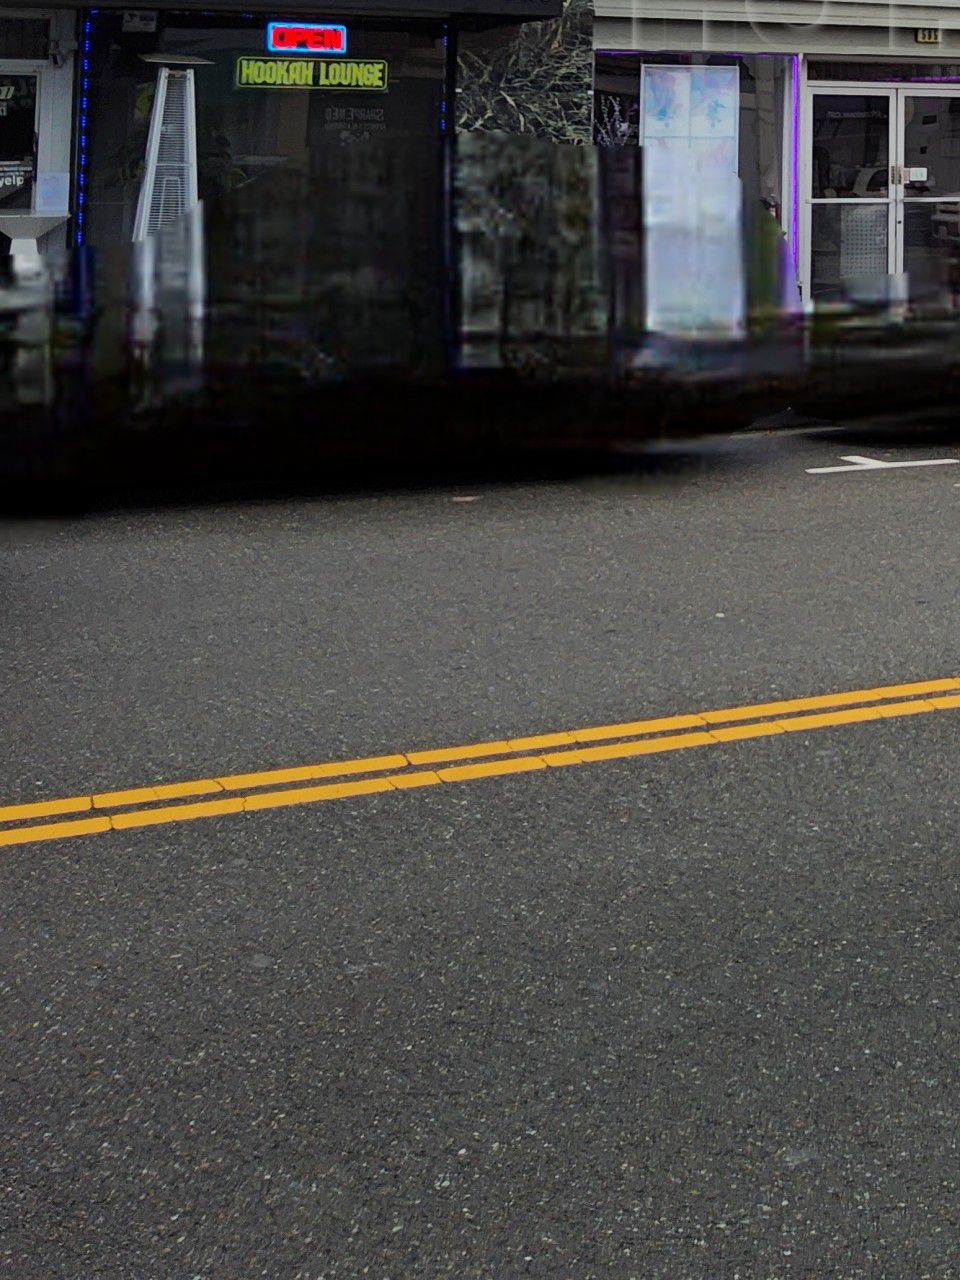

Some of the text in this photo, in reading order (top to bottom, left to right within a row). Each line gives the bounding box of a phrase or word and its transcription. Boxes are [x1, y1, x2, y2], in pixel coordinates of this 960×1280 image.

[272, 27, 343, 49] OPEN
[241, 60, 383, 87] HOOKAH LOUNGE
